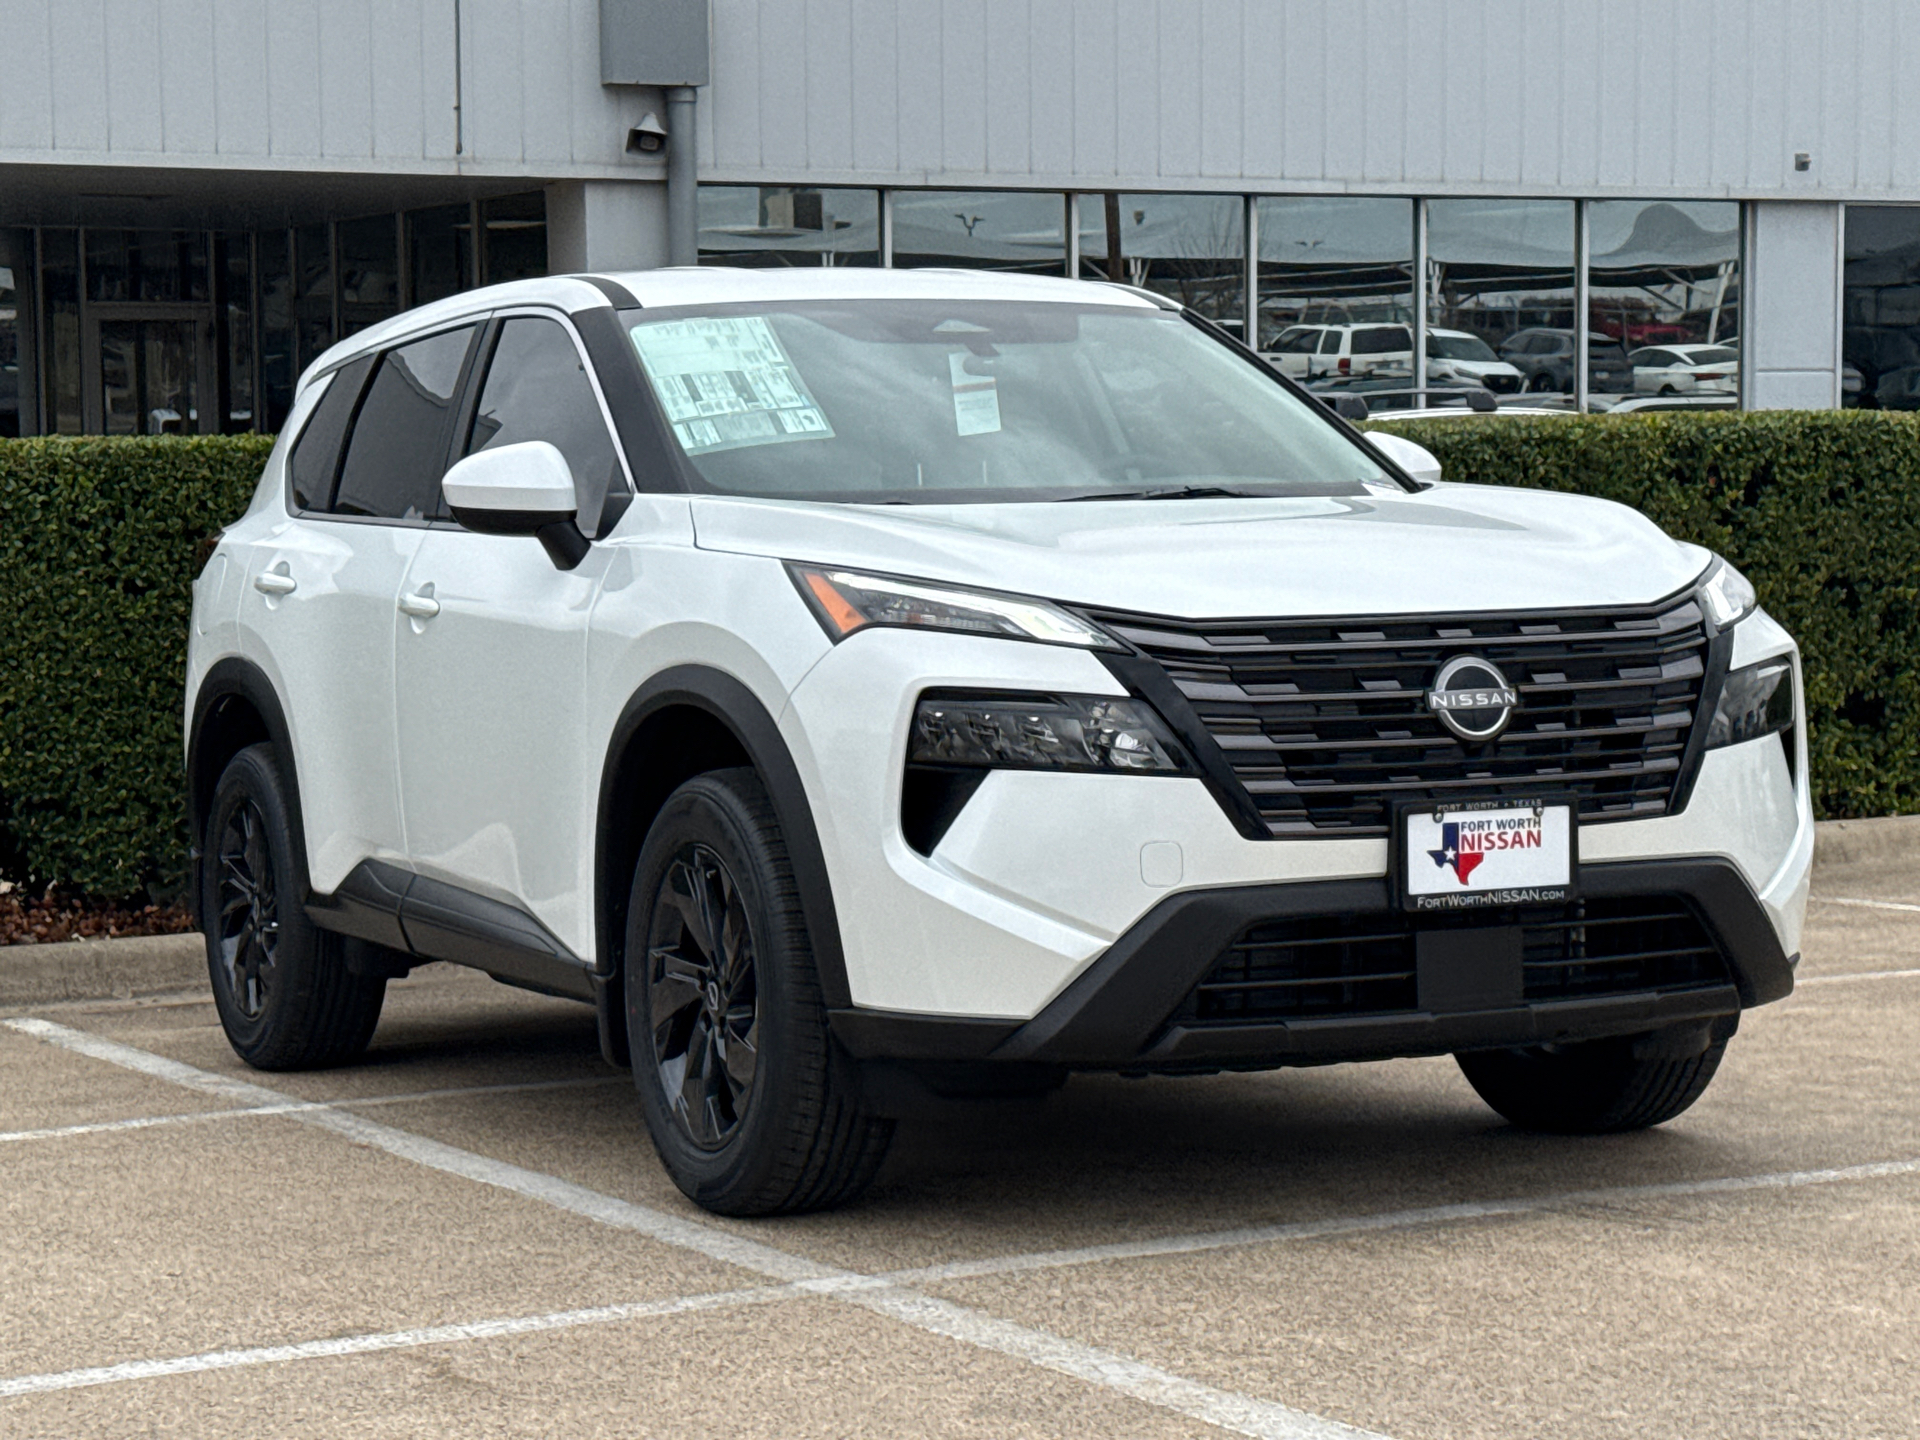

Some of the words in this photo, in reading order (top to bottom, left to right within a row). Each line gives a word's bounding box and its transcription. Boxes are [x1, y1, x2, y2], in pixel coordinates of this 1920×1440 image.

[1432, 691, 1516, 707] NISSAN
[1437, 803, 1461, 812] FORT
[1465, 801, 1499, 811] WORTH
[1513, 799, 1542, 808] TEXAS
[1461, 820, 1492, 832] FORT
[1496, 817, 1541, 830] WORTH
[1461, 829, 1541, 852] NISSAN
